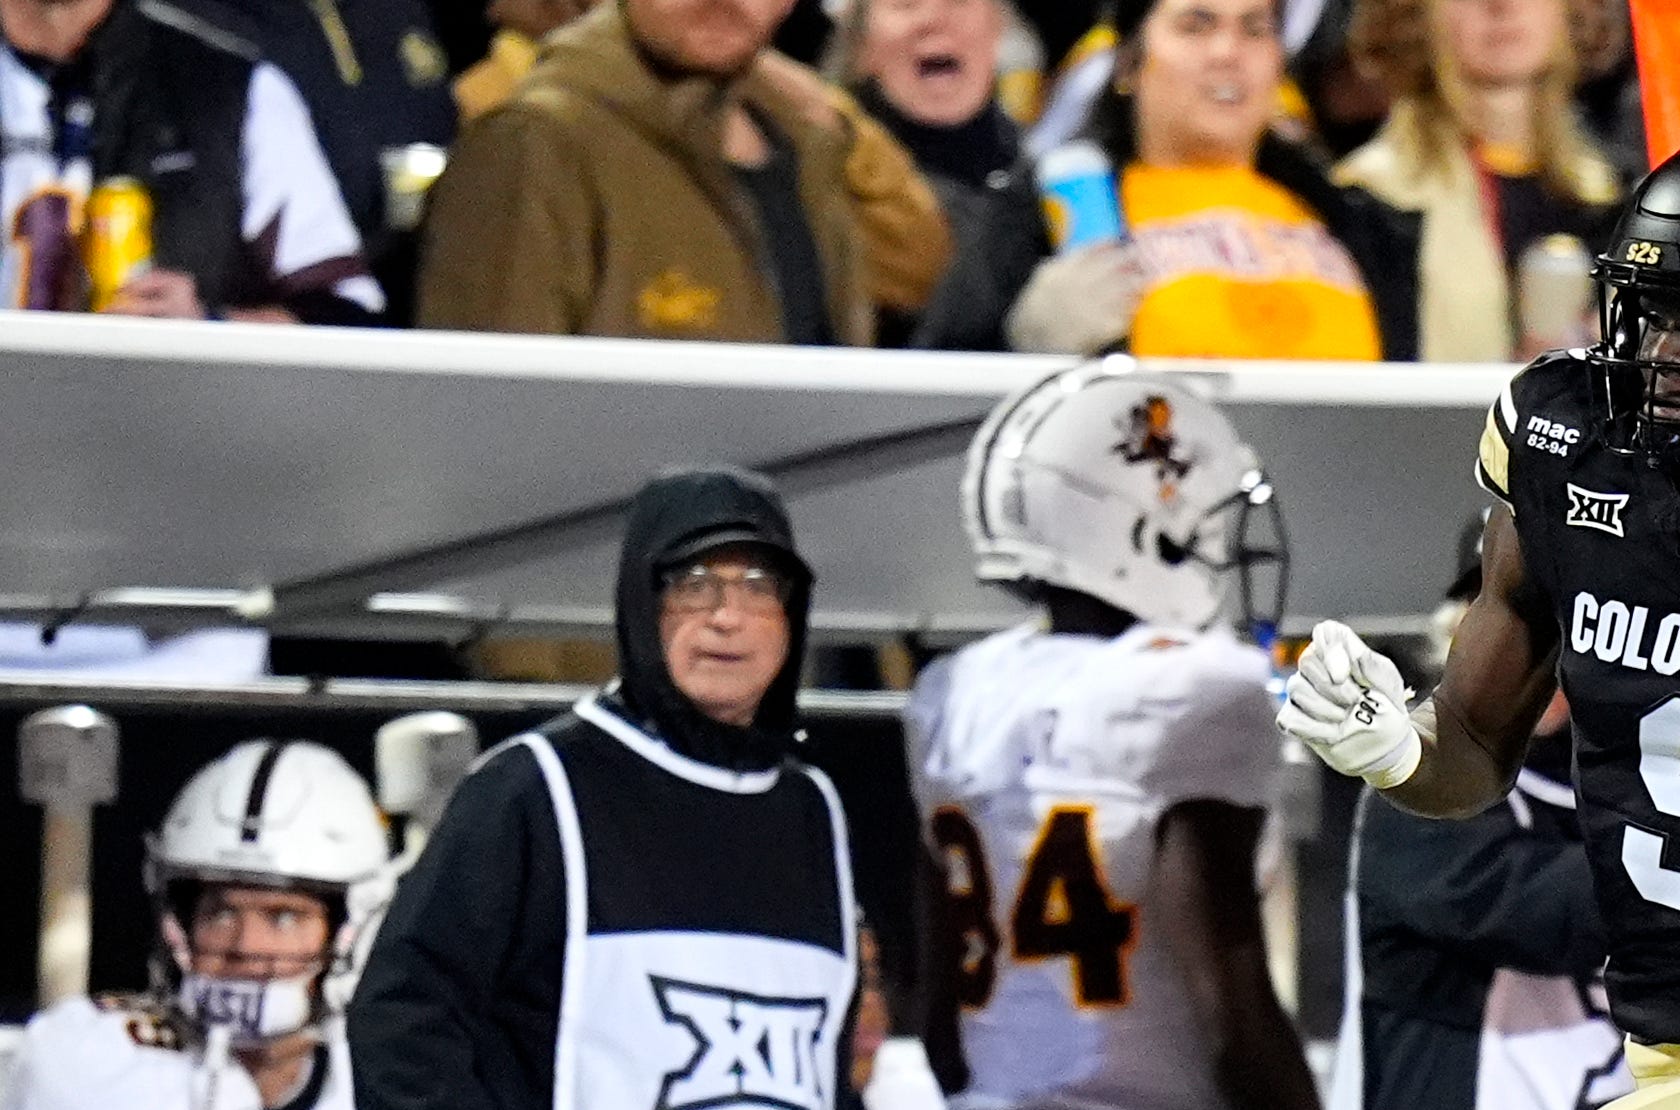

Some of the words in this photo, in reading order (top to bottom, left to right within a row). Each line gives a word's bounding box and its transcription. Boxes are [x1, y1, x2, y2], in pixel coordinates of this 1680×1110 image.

[1626, 242, 1661, 265] s2s
[1527, 416, 1580, 444] mac
[1527, 433, 1569, 458] 82-94
[1566, 482, 1630, 538] XII
